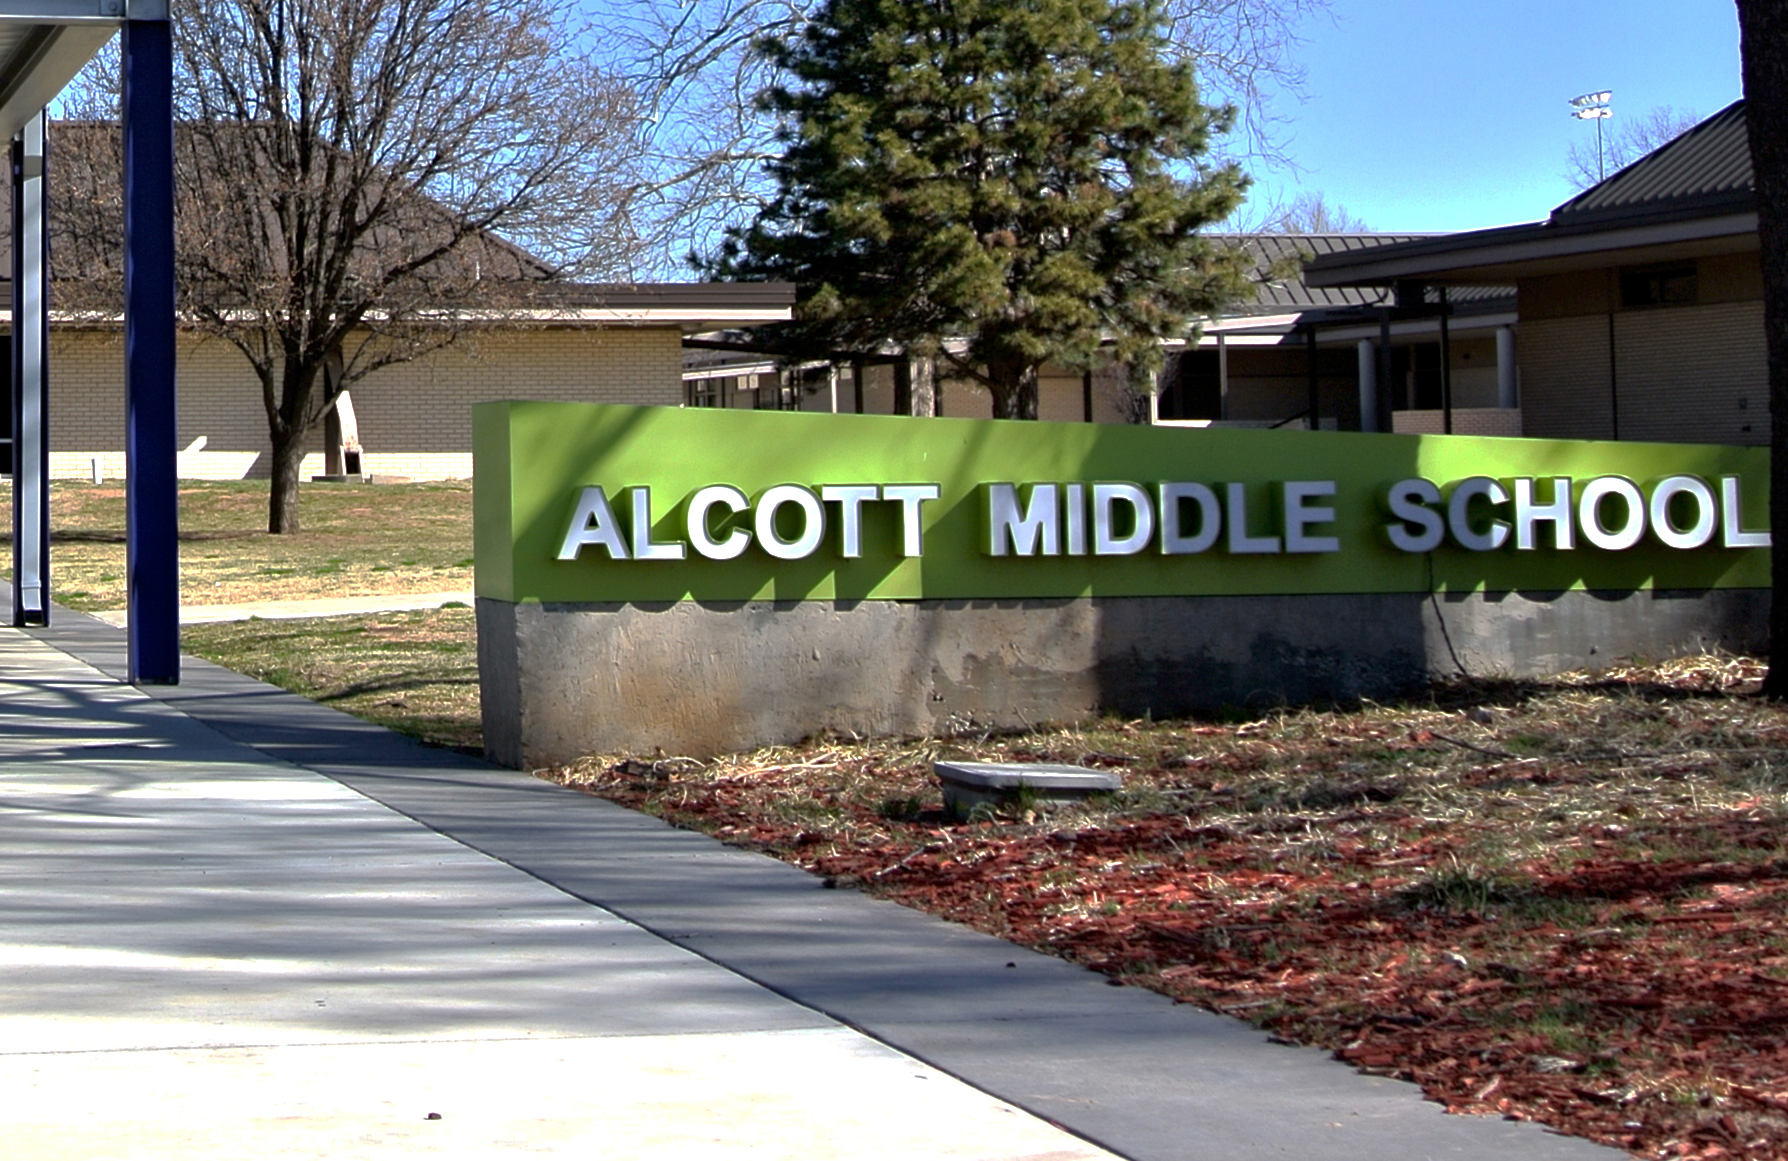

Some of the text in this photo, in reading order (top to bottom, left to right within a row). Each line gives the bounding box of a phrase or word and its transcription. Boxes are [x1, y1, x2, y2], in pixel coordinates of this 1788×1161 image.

[556, 474, 1772, 561] ALCOTT MIDDLE SCHOOL
